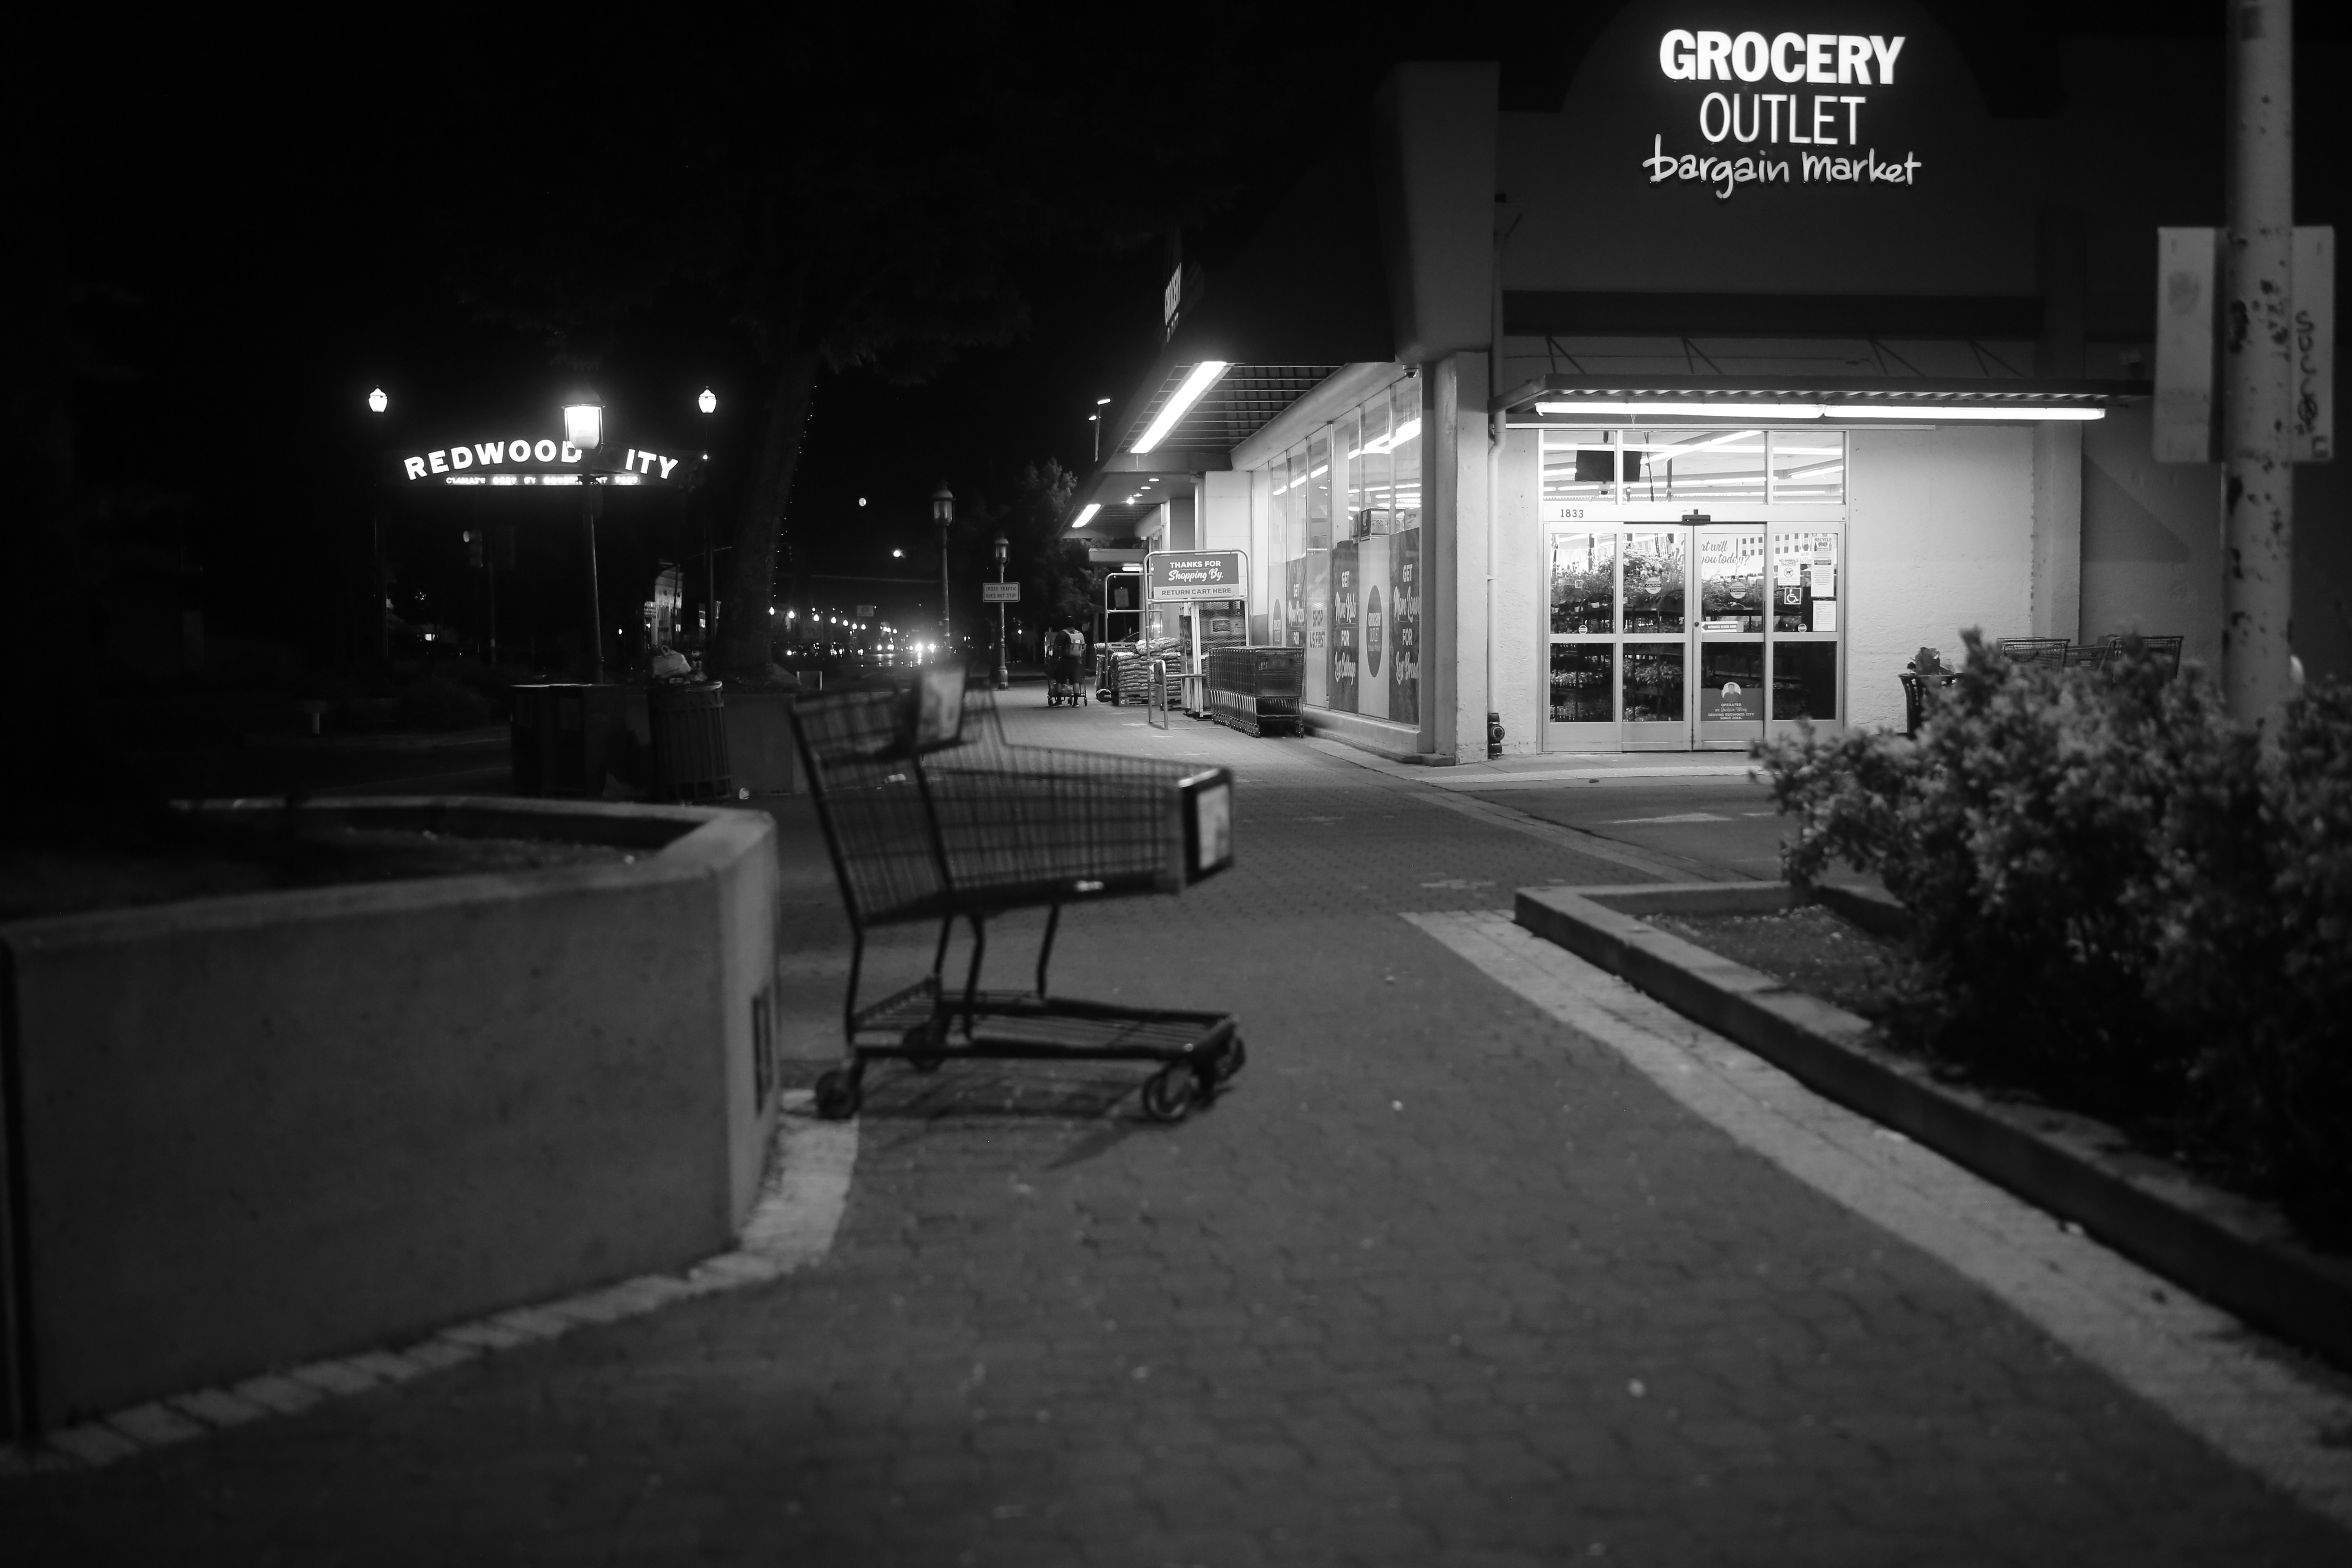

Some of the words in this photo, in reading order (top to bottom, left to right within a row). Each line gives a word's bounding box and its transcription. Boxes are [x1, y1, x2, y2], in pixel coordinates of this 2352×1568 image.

[1659, 28, 1906, 85] GROCERY
[1699, 91, 1866, 146] OUTLET
[1642, 133, 1789, 200] bargain
[1801, 147, 1922, 185] market
[403, 439, 584, 481] REDWOOD
[1560, 509, 1584, 518] 1833
[1711, 540, 1728, 552] will
[1168, 570, 1207, 582] Shopping
[1208, 568, 1224, 581] By.
[1341, 571, 1350, 588] GET
[1403, 564, 1413, 583] GET
[1393, 586, 1407, 621] More
[1313, 610, 1323, 627] SHOP
[1310, 632, 1315, 648] US
[1315, 631, 1325, 648] FIRST
[1341, 630, 1350, 646] FOR
[1402, 628, 1413, 646] FOR
